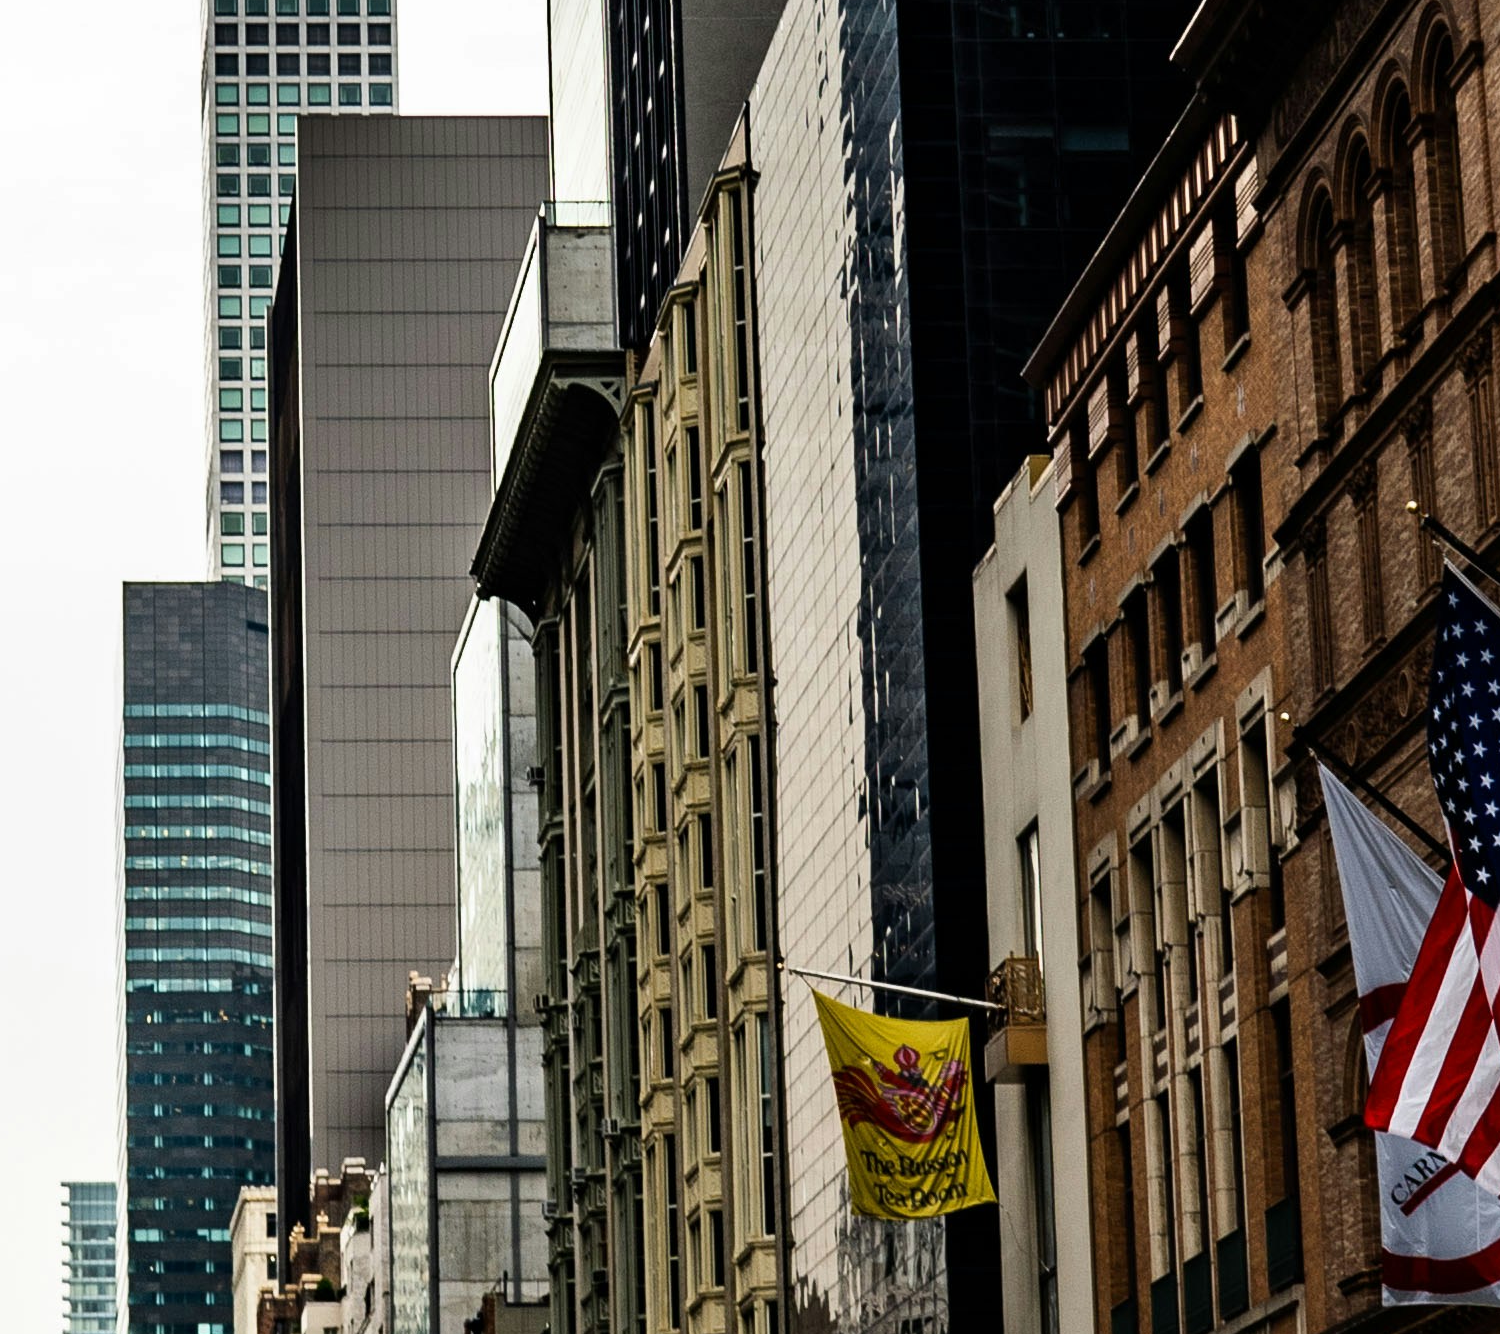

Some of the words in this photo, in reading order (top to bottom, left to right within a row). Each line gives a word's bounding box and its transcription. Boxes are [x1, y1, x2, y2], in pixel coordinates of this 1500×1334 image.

[861, 1149, 896, 1175] The
[898, 1148, 968, 1177] Russian
[1391, 1151, 1449, 1206] CARN
[874, 1182, 908, 1207] Tea
[911, 1182, 968, 1211] Room
